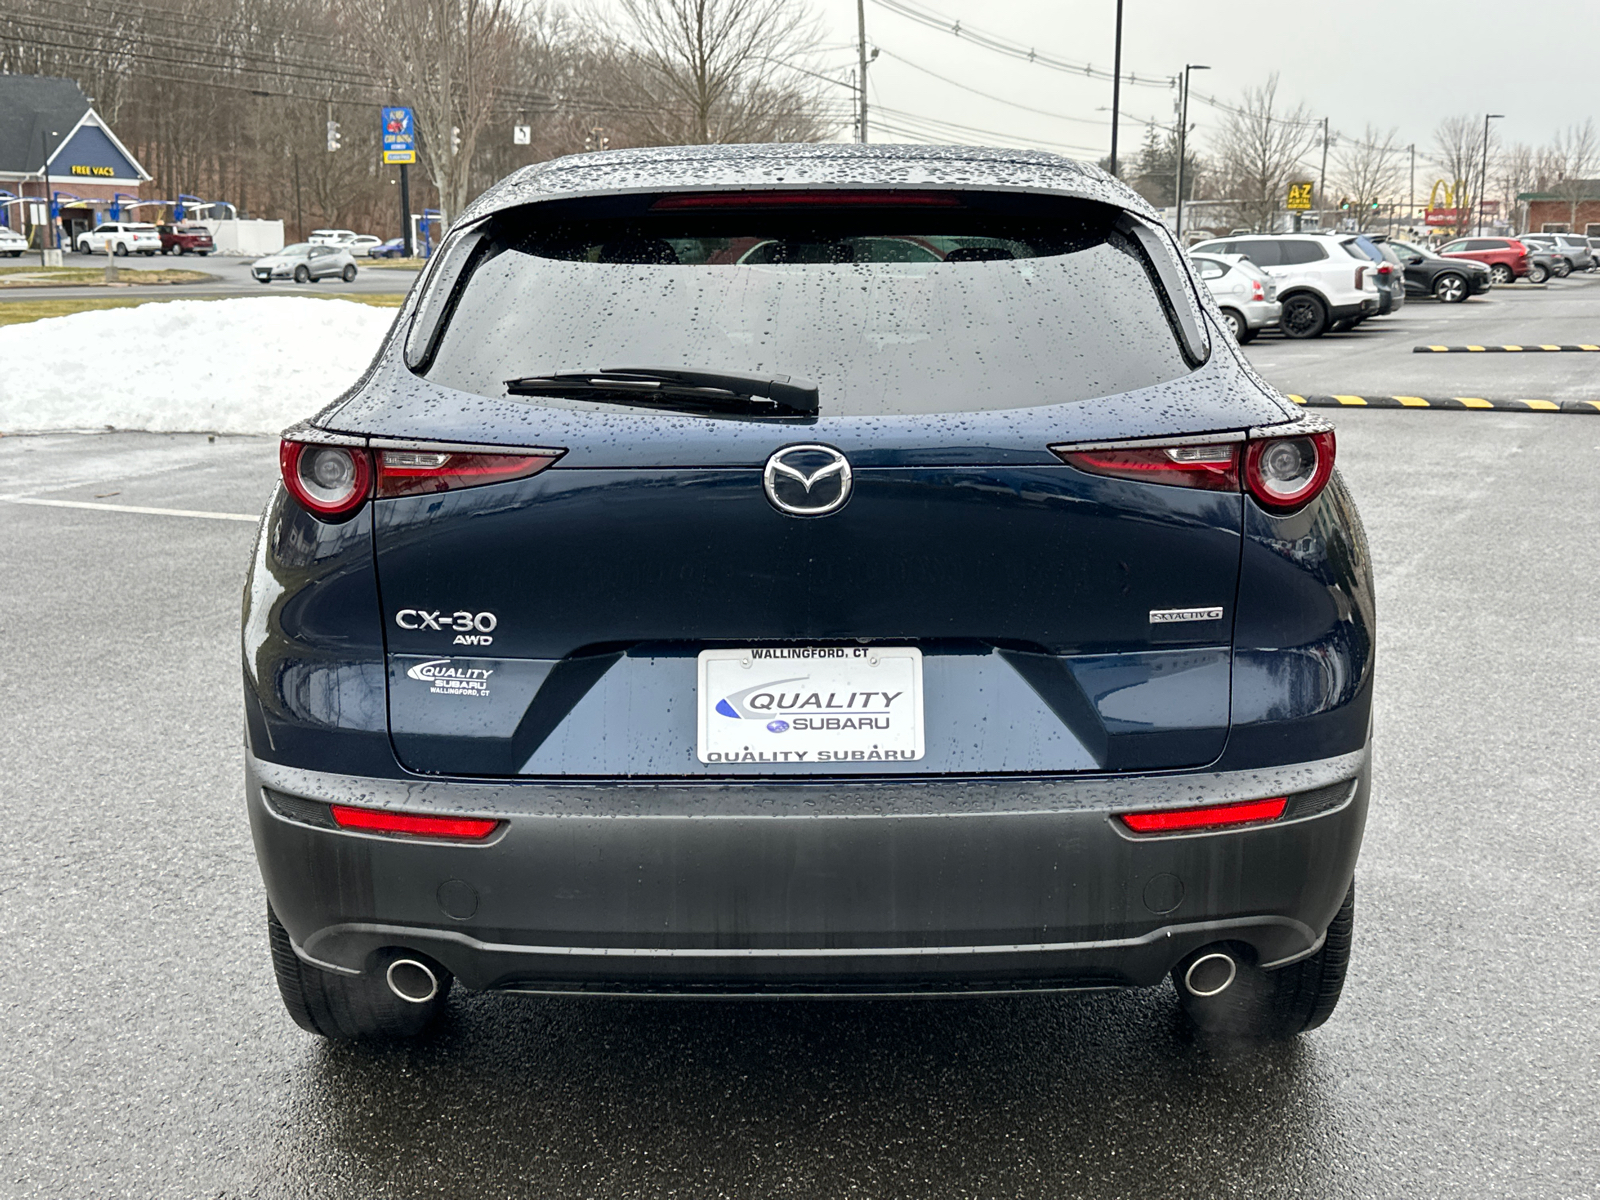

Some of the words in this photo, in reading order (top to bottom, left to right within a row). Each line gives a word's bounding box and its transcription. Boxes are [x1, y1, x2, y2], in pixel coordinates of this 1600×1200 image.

[71, 164, 90, 175] FREE
[92, 166, 114, 176] VACS
[1289, 184, 1311, 198] A-Z
[395, 609, 497, 633] CX-30
[452, 635, 493, 646] AWD
[751, 648, 848, 659] WALLINGFORD,
[853, 648, 869, 658] CT
[422, 667, 493, 679] QUALITY
[434, 679, 487, 690] SUBARU
[430, 688, 479, 697] WALLINGFORD,
[749, 692, 904, 710] QUALITY
[792, 717, 890, 730] SUBARU
[706, 751, 809, 763] QUALITY
[817, 750, 916, 761] SUBARU
